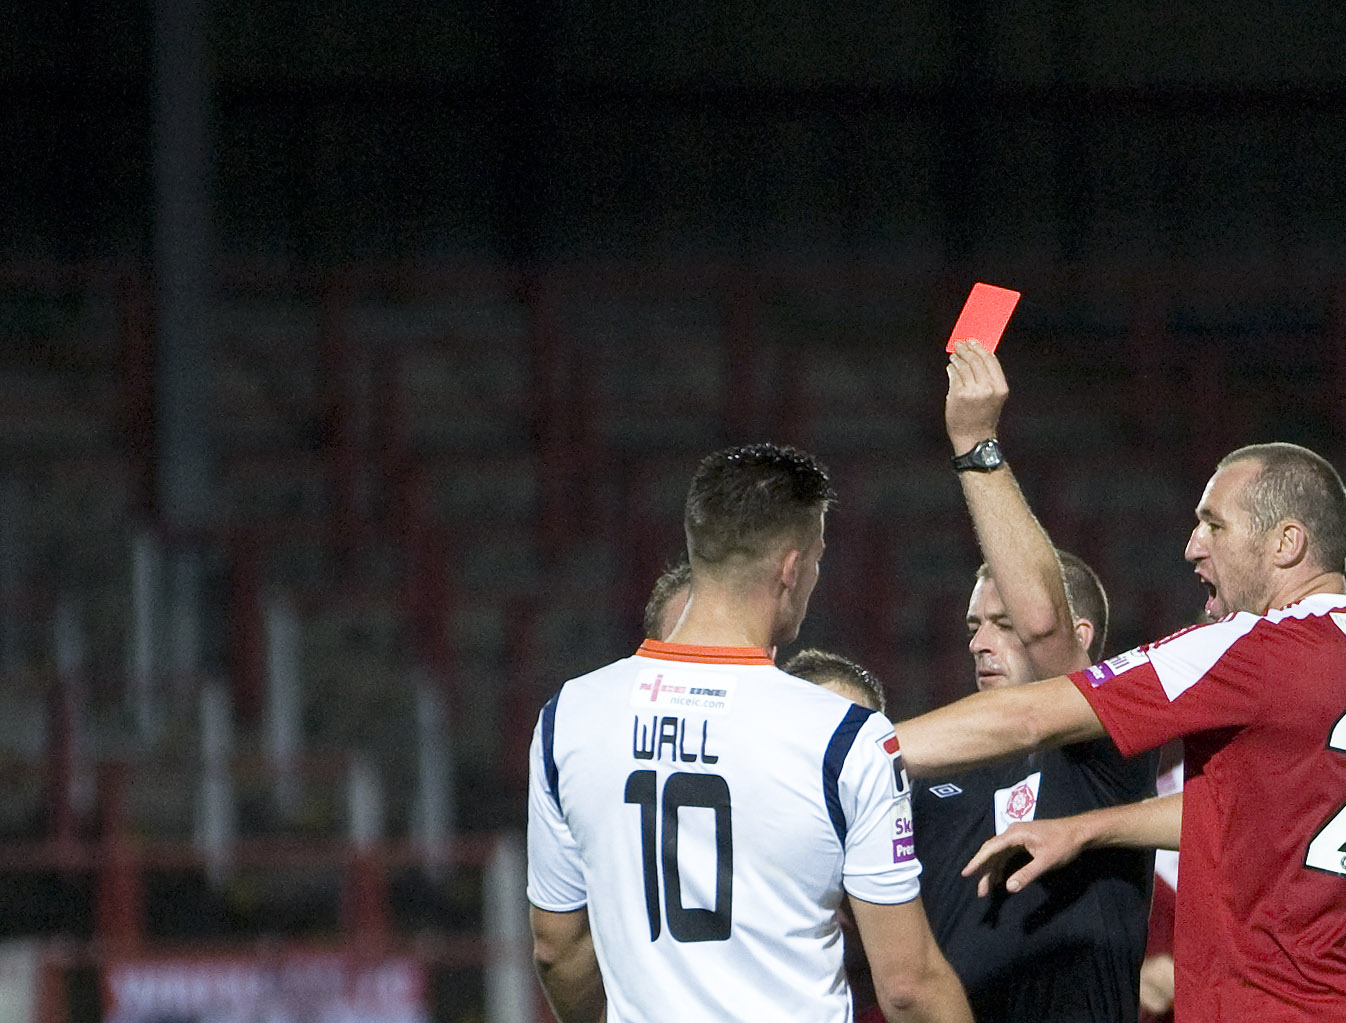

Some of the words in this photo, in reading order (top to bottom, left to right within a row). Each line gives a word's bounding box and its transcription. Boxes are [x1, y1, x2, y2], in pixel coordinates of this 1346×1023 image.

[670, 696, 726, 709] niceic.com
[633, 715, 719, 765] WALL
[624, 770, 733, 943] 10
